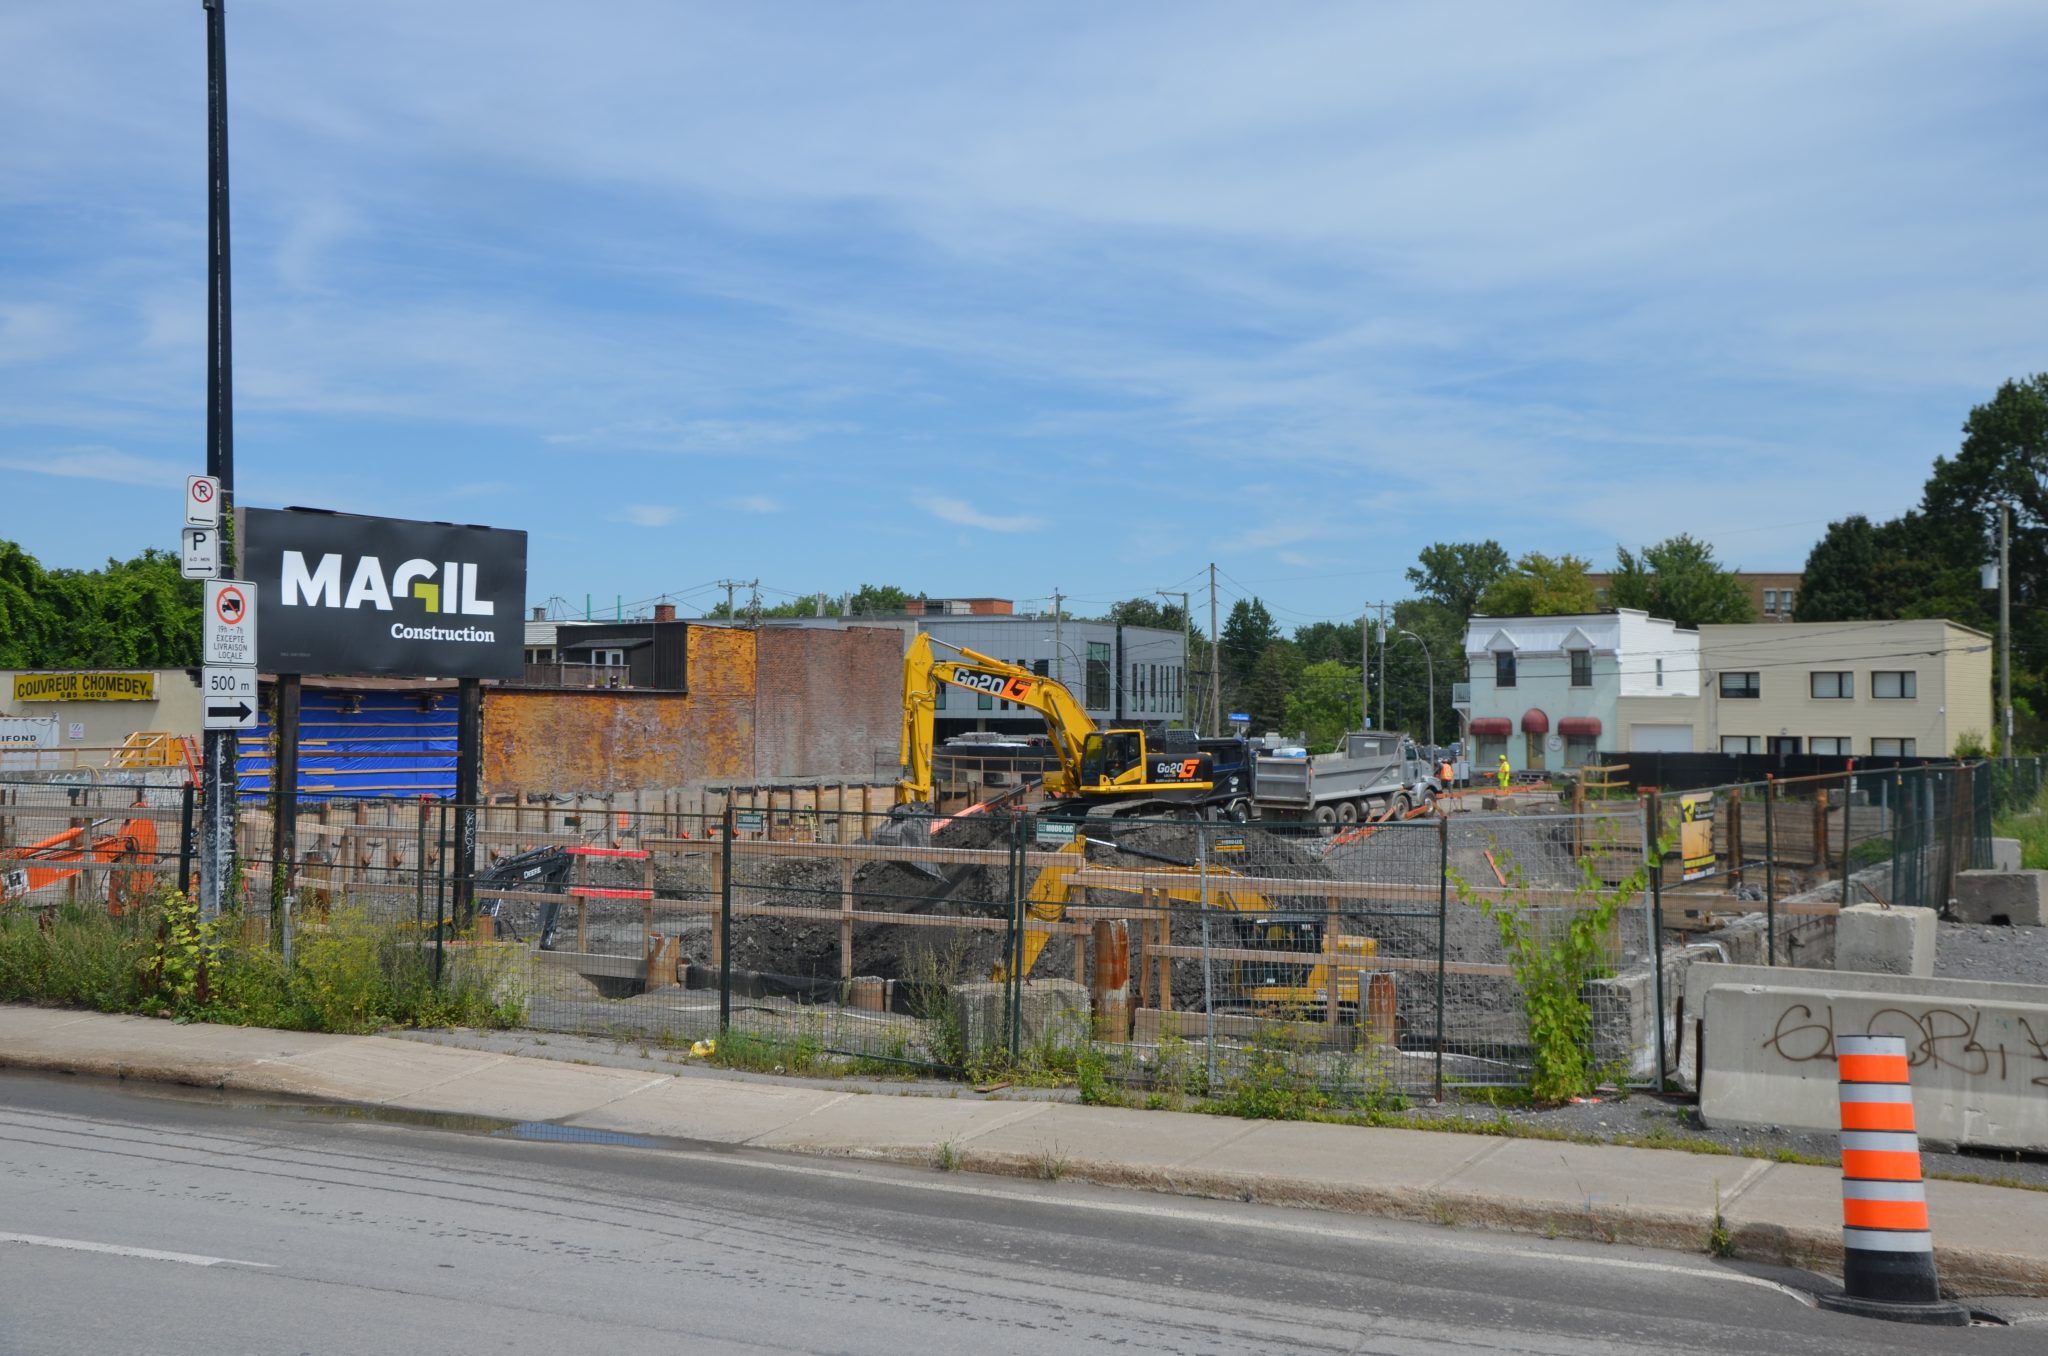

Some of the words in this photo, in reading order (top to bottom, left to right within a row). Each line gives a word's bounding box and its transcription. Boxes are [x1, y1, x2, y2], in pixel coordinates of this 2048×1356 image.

[193, 532, 206, 551] P
[281, 550, 495, 616] MAGIL
[390, 623, 496, 643] Construction
[213, 643, 248, 652] LIVRAISON
[218, 651, 243, 660] LOCALE
[17, 677, 78, 698] COUVREUR
[82, 675, 148, 696] CHOMEDEY
[211, 675, 236, 691] 500
[240, 683, 250, 691] m
[523, 866, 541, 880] DEERE
